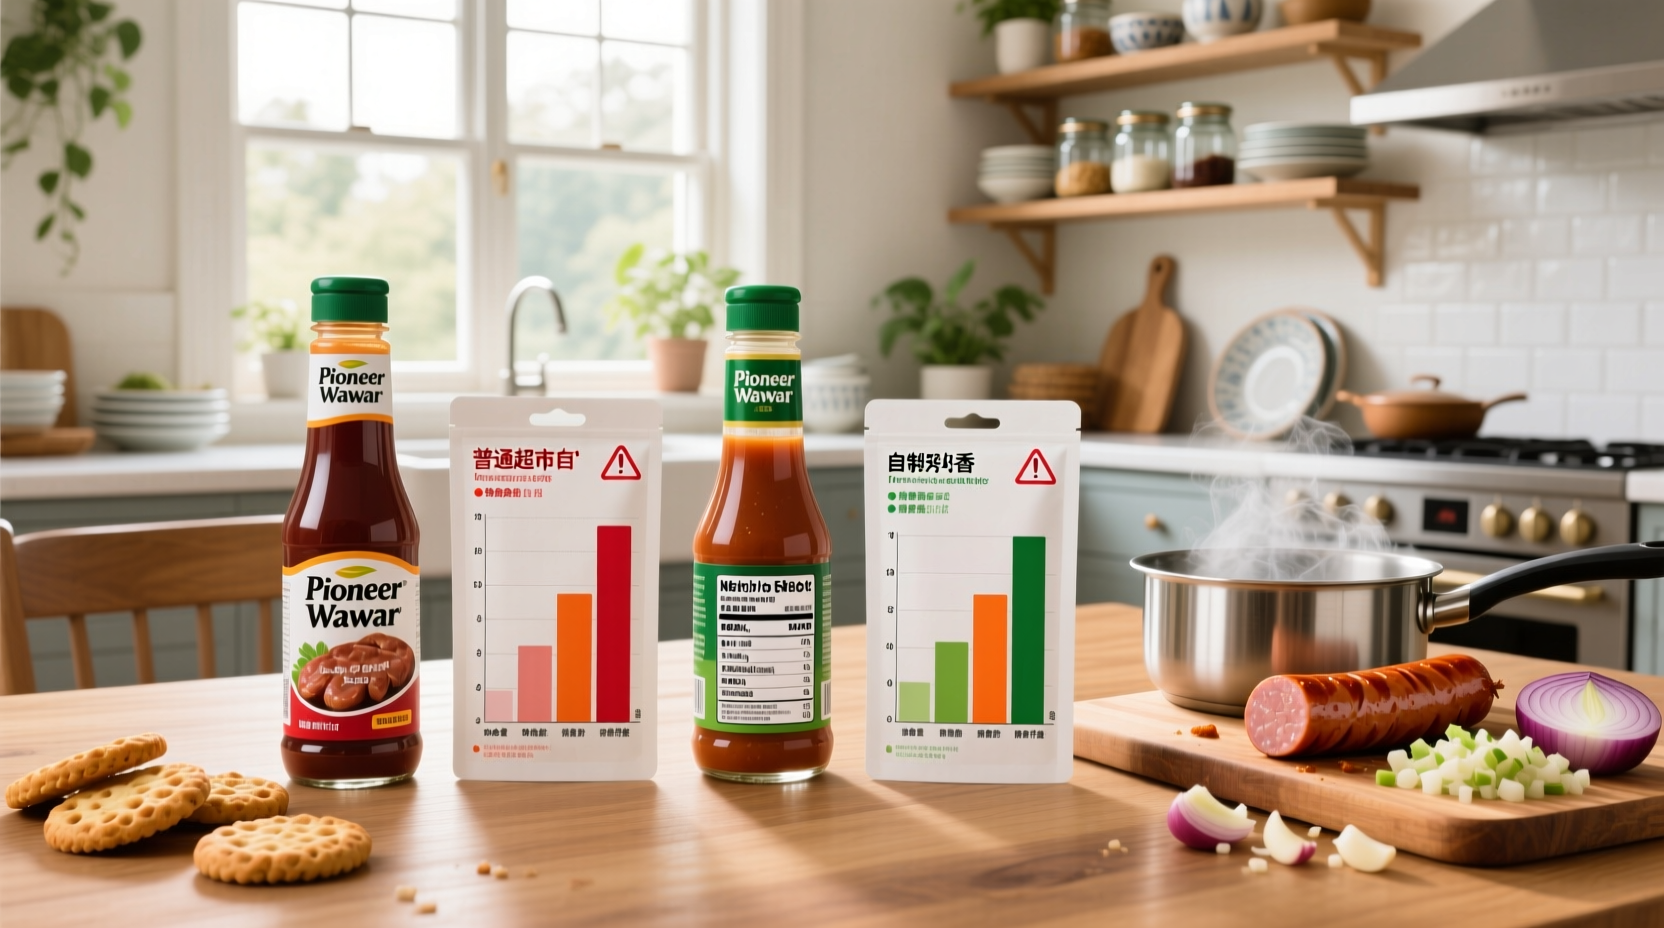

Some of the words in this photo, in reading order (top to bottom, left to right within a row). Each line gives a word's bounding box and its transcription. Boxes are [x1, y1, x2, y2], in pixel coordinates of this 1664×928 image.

[319, 366, 385, 385] Pioneer
[734, 370, 795, 387] Pioneer
[320, 387, 383, 404] Wawar
[734, 387, 793, 403] Wawar
[305, 575, 402, 601] Pioneer
[306, 604, 400, 628] Wawar
